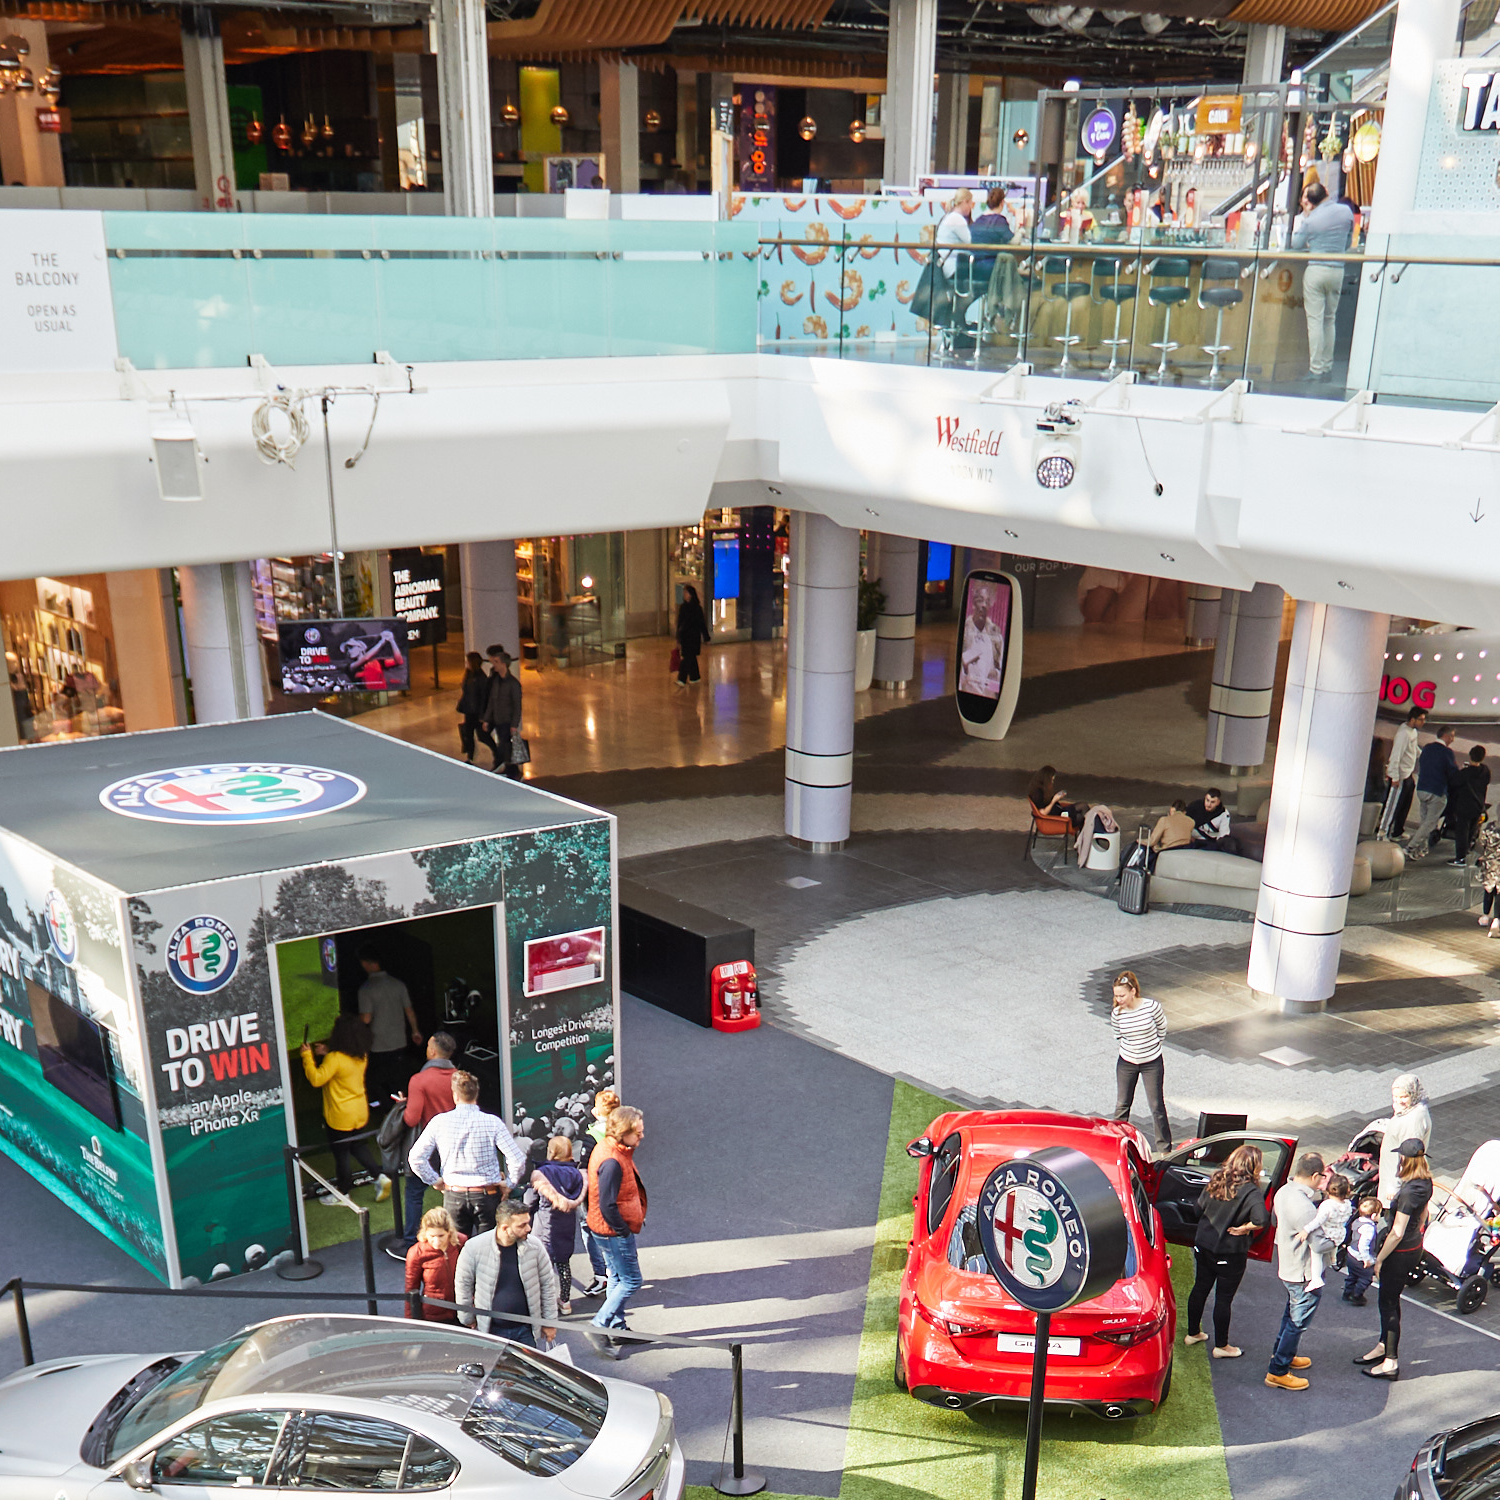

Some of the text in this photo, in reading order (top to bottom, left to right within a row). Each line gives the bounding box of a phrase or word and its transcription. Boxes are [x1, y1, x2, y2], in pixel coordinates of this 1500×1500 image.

[31, 253, 59, 268] THE
[15, 272, 79, 287] BALCONY
[27, 304, 77, 318] OPEN AS
[35, 319, 74, 333] USUAL
[935, 415, 1004, 457] Westfield
[977, 467, 993, 483] W12
[393, 569, 411, 584] THE
[1015, 562, 1036, 573] OUR
[394, 578, 442, 598] ABNORMAL
[394, 594, 427, 612] BEAUTY
[299, 656, 311, 665] TO
[300, 646, 328, 656] DRIVE
[1379, 674, 1437, 710] OG
[113, 765, 336, 807] ALFA ROMEO
[168, 918, 237, 961] ALFA ROMEO
[165, 1012, 260, 1059] DRIVE
[531, 1019, 592, 1040] Longest Drive
[535, 1033, 590, 1053] Competition
[161, 1043, 271, 1092] TO WIN
[191, 1088, 252, 1115] an Apple
[190, 1111, 239, 1136] iPhone
[983, 1169, 1084, 1259] ALFA ROMEO
